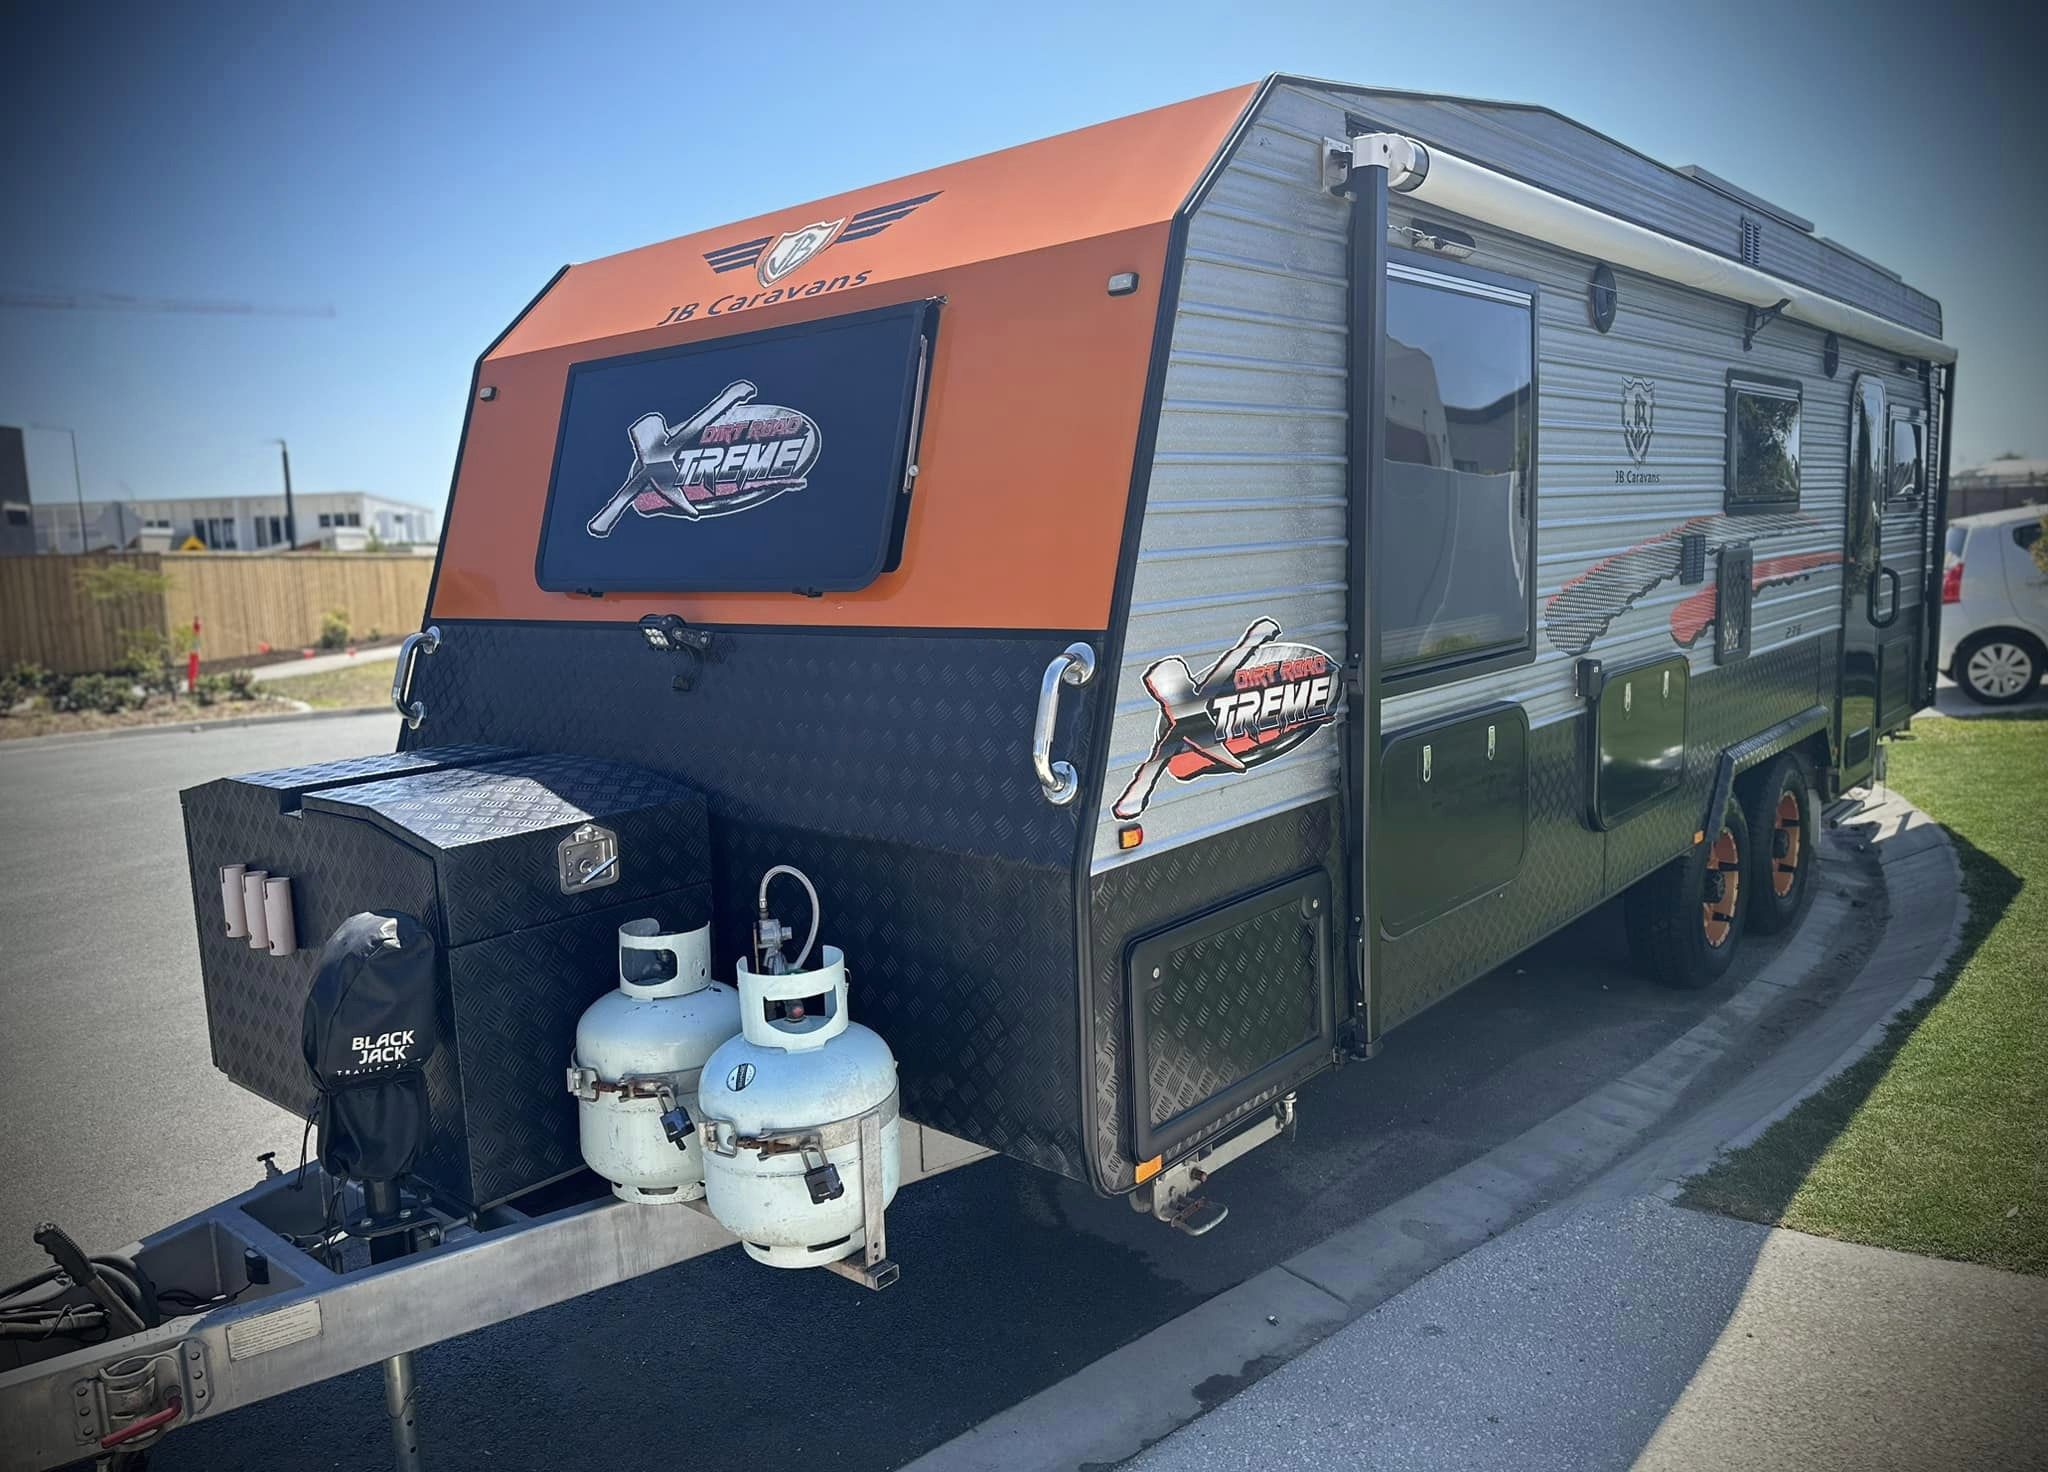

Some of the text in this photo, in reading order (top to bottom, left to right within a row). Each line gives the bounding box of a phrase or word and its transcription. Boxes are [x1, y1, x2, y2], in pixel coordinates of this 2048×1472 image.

[656, 269, 873, 326] JB Caravans
[700, 415, 802, 444] DIRT ROAD
[1615, 470, 1661, 484] JB Caravans
[1233, 655, 1326, 690] DIRT ROAD
[352, 1030, 415, 1051] BLACK
[358, 1046, 407, 1065] JACK
